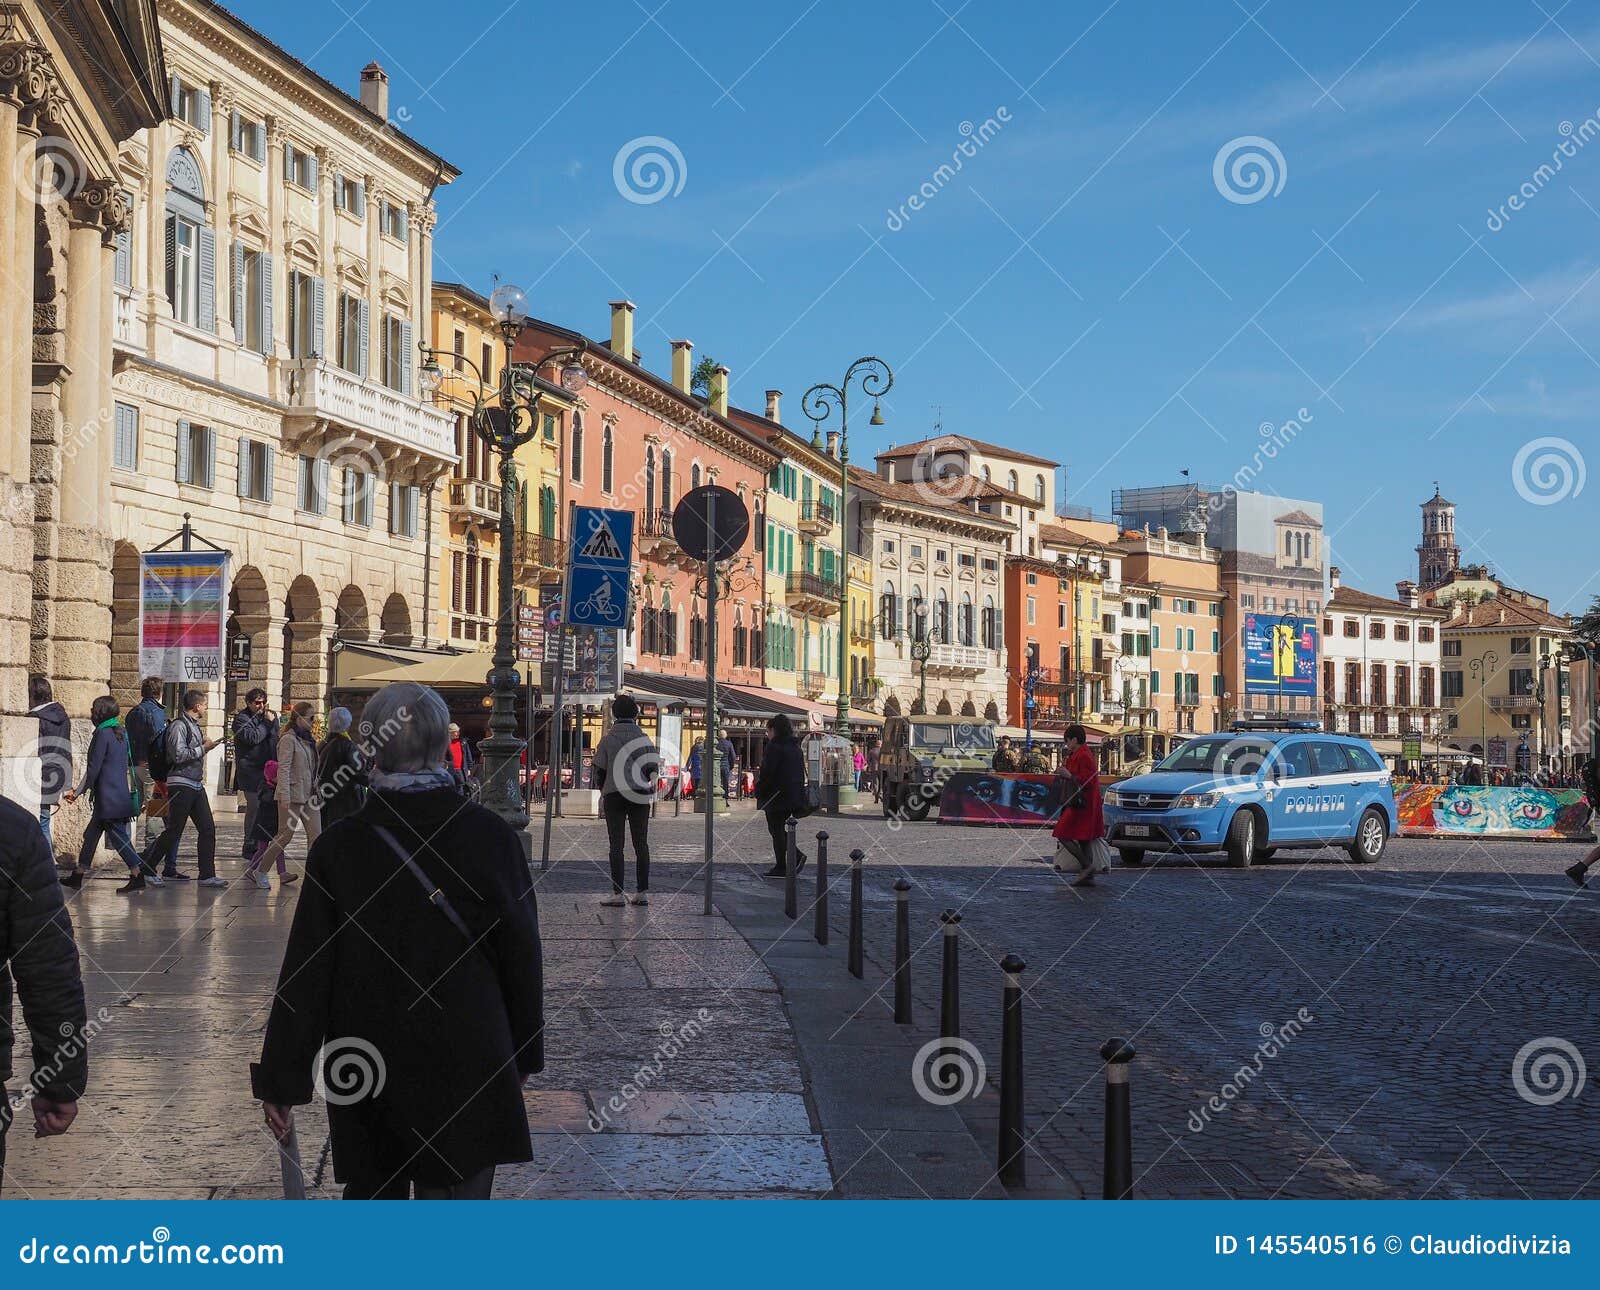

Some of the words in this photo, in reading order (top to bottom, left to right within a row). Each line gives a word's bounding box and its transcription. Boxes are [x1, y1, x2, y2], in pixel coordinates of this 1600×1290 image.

[184, 656, 219, 669] PRIMA
[184, 667, 219, 680] VERA
[1285, 794, 1345, 814] POLIZIA
